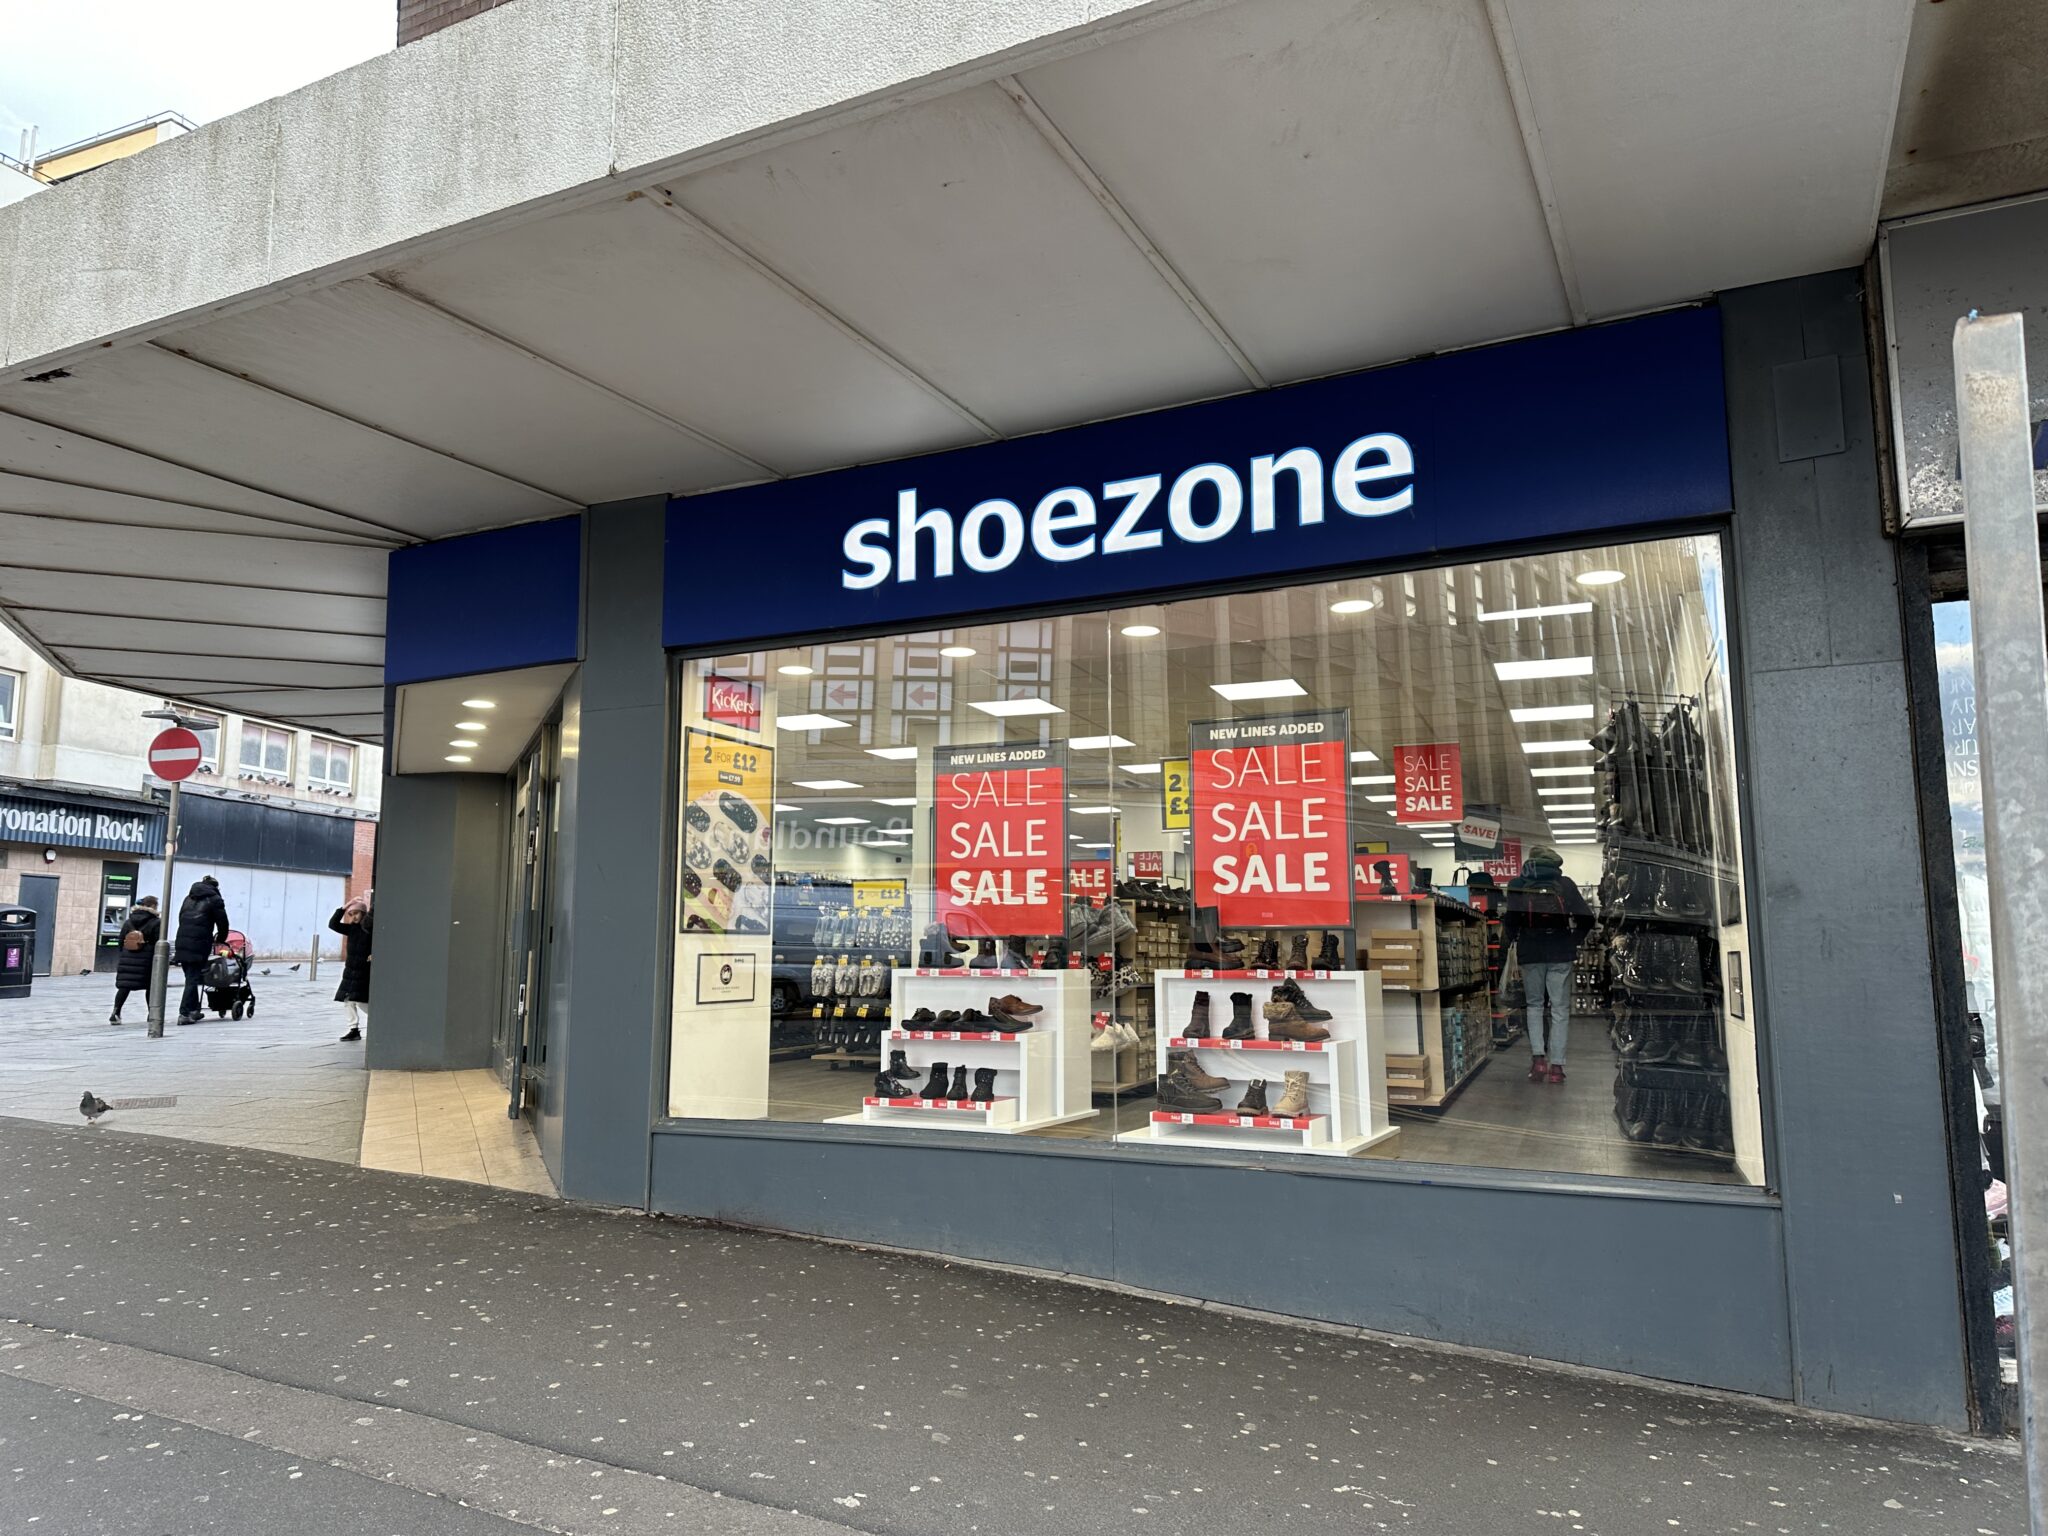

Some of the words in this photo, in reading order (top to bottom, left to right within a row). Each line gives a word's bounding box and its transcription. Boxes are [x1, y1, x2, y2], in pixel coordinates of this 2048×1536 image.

[841, 432, 1415, 590] shoezone
[1209, 728, 1238, 740] NEW
[1241, 725, 1276, 739] LINES
[1279, 722, 1324, 736] ADDED
[704, 746, 712, 764] 2
[733, 752, 756, 773] £12
[950, 754, 975, 766] NEW
[977, 751, 1007, 764] LINES
[1008, 749, 1046, 761] ADDED
[1211, 742, 1326, 789] SALE
[1404, 753, 1451, 772] SALE
[951, 768, 1047, 809] SALE
[1169, 774, 1182, 792] 2
[1405, 775, 1452, 792] SALE
[1405, 795, 1453, 812] SALE
[94, 814, 144, 843] Rock
[1212, 798, 1328, 843] SALE
[1463, 824, 1497, 840] SAVE!
[950, 819, 1047, 859] SALE
[1070, 868, 1106, 888] ALE
[1213, 852, 1330, 894] SALE
[1355, 861, 1398, 884] ALE
[1489, 867, 1517, 877] SALE
[950, 869, 1048, 907] SALE
